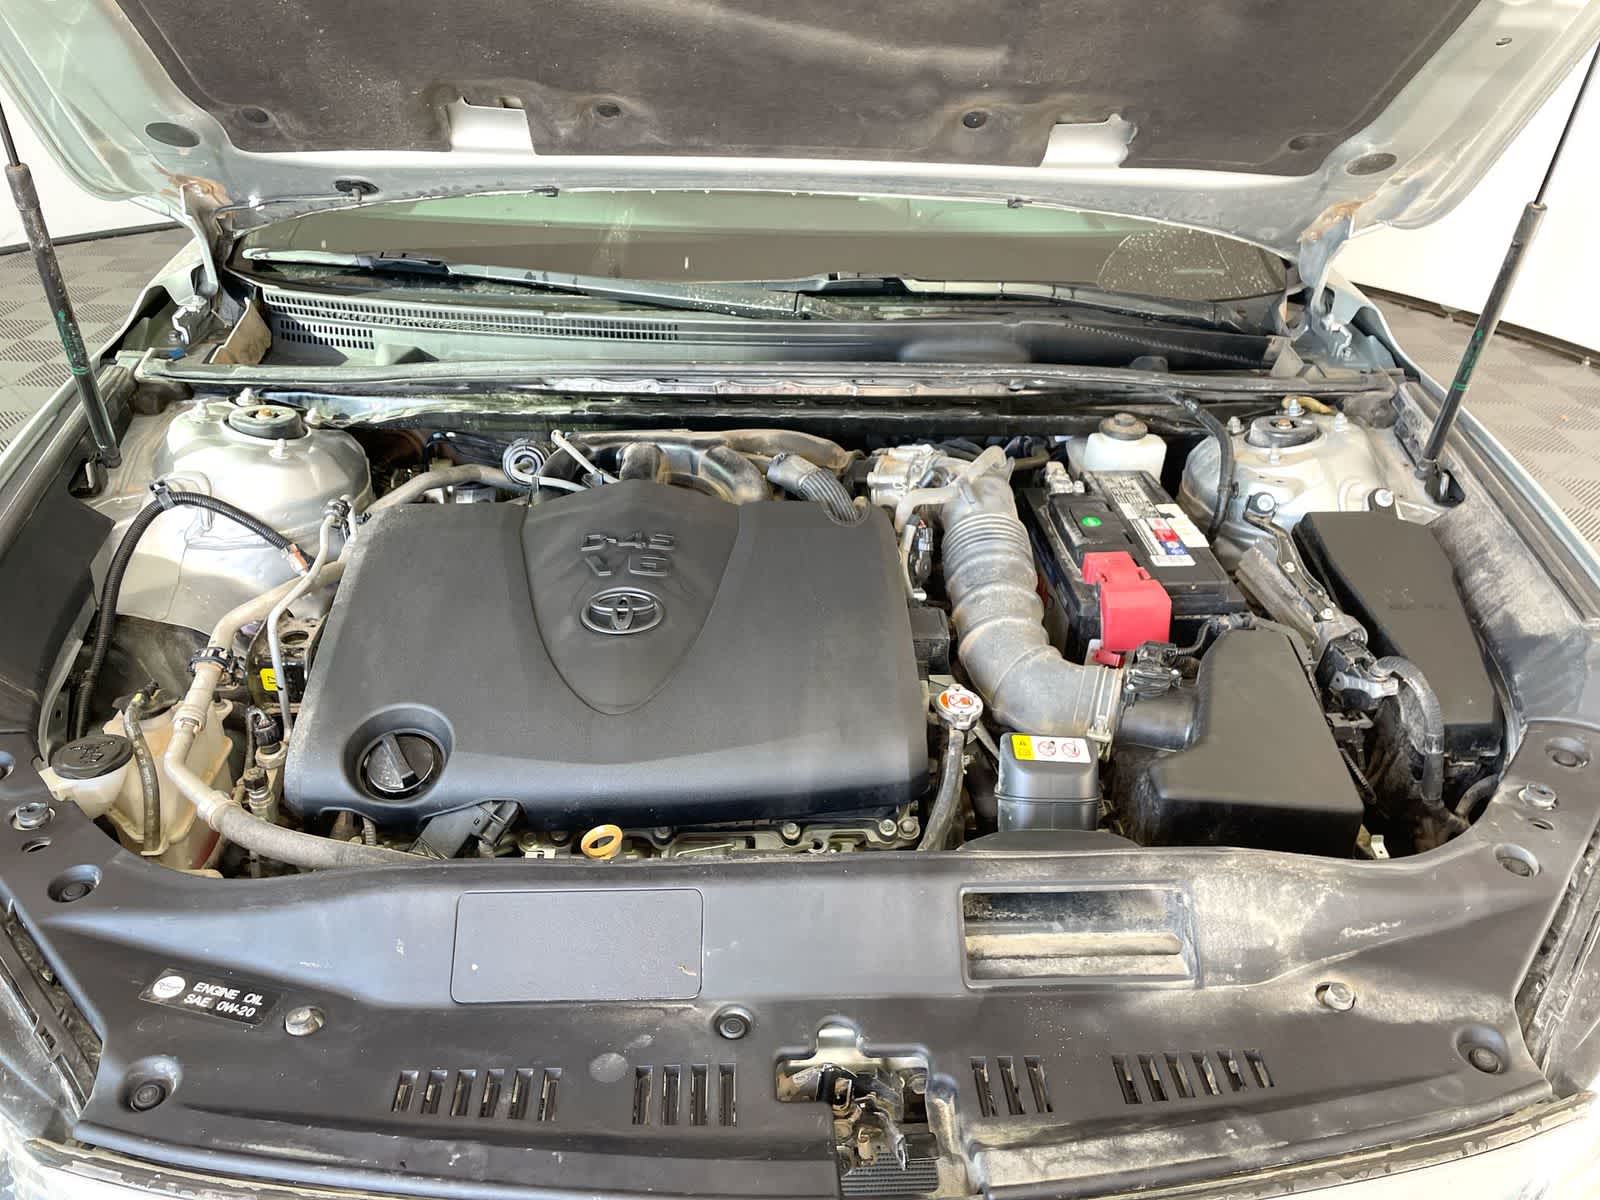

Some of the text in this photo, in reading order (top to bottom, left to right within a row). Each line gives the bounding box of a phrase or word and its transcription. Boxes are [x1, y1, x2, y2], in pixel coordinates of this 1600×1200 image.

[584, 555, 671, 577] V6
[183, 993, 256, 1018] SAE 0W-20
[193, 982, 240, 1000] ENGINE
[243, 993, 263, 1006] OIL
